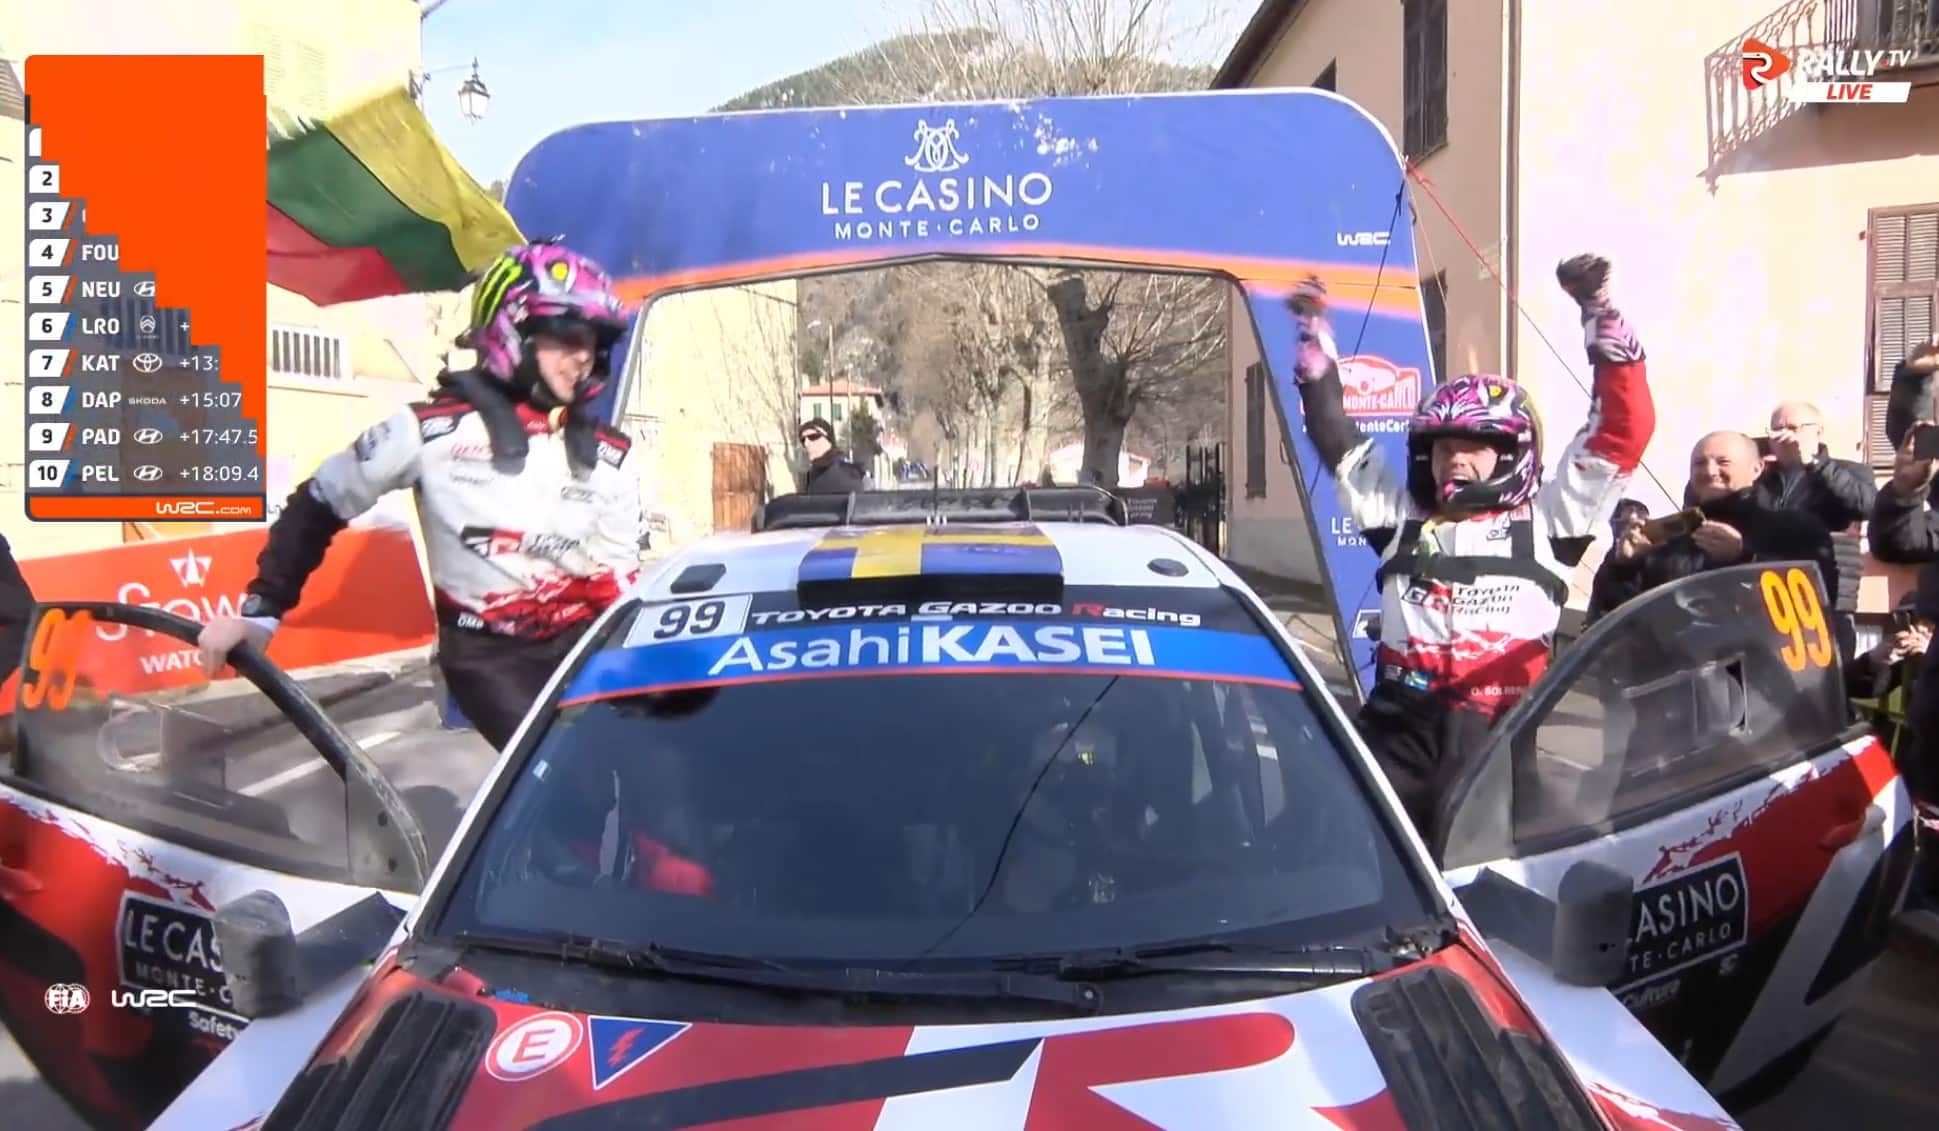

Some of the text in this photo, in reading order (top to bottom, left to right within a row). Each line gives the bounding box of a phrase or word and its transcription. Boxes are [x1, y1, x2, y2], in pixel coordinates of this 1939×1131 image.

[822, 172, 1053, 214] LE CASINO
[1336, 231, 1391, 246] WRC
[1331, 517, 1353, 535] LE
[653, 600, 727, 641] 99
[752, 600, 1202, 627] TOYOTA GAZOO Racing
[1759, 567, 1833, 673] 99
[22, 608, 94, 711] 99
[124, 909, 160, 953] LE
[511, 1027, 557, 1064] E
